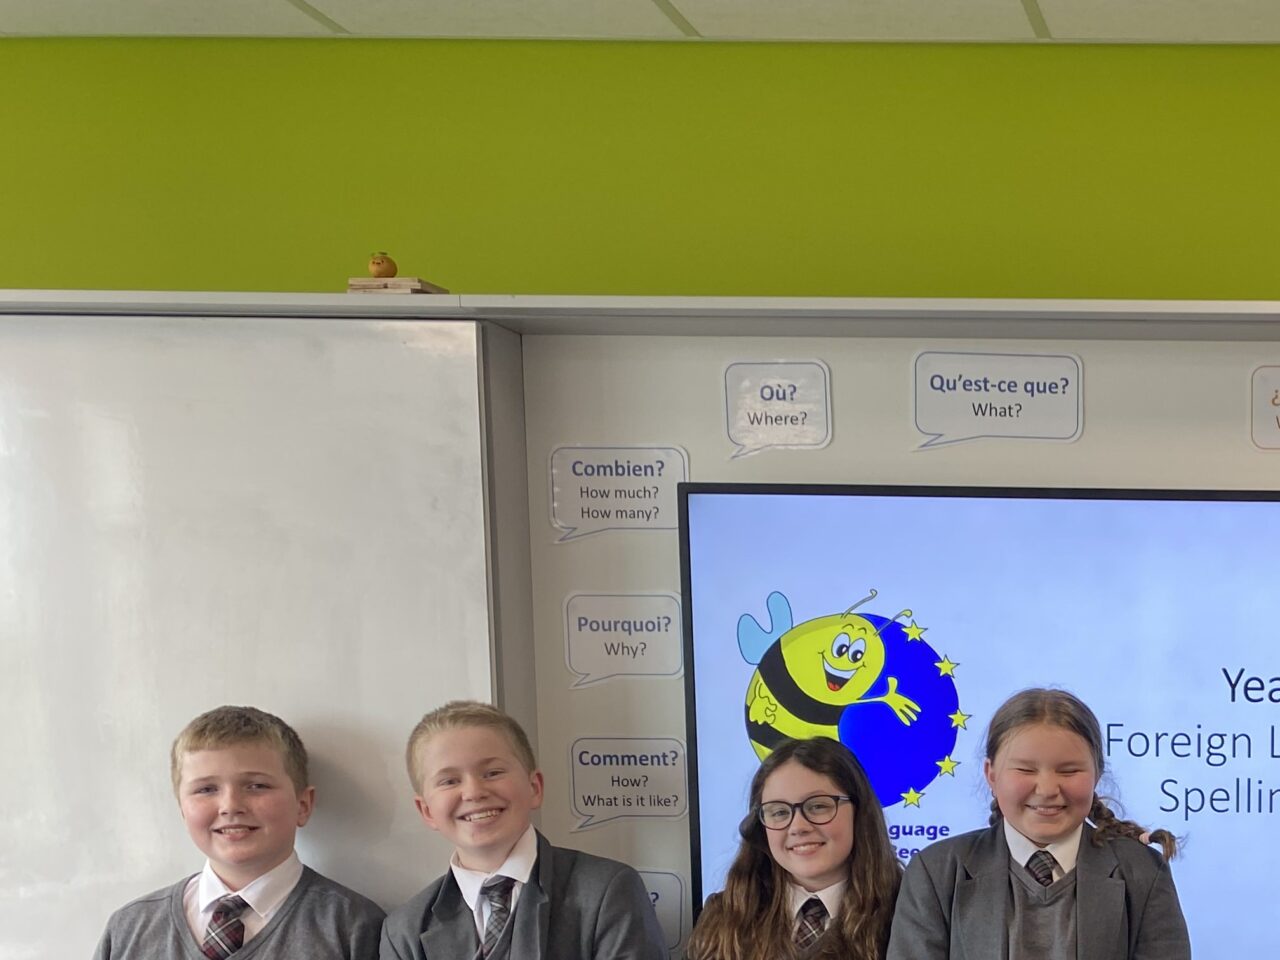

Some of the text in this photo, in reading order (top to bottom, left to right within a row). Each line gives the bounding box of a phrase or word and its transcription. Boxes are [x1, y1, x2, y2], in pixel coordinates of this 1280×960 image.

[760, 384, 797, 401] Où?
[1023, 377, 1070, 397] que?
[972, 402, 1023, 418] What?
[747, 412, 808, 426] Where?
[571, 460, 665, 477] Combien?
[580, 486, 659, 499] How much?
[581, 506, 659, 522] How many?
[577, 616, 671, 636] Pourquoi?
[604, 642, 647, 659] Why?
[1105, 723, 1252, 767] Foreign
[578, 750, 679, 766] Comment?
[611, 775, 649, 788] How?
[582, 794, 679, 807] What is it like?
[888, 824, 950, 840] guage
